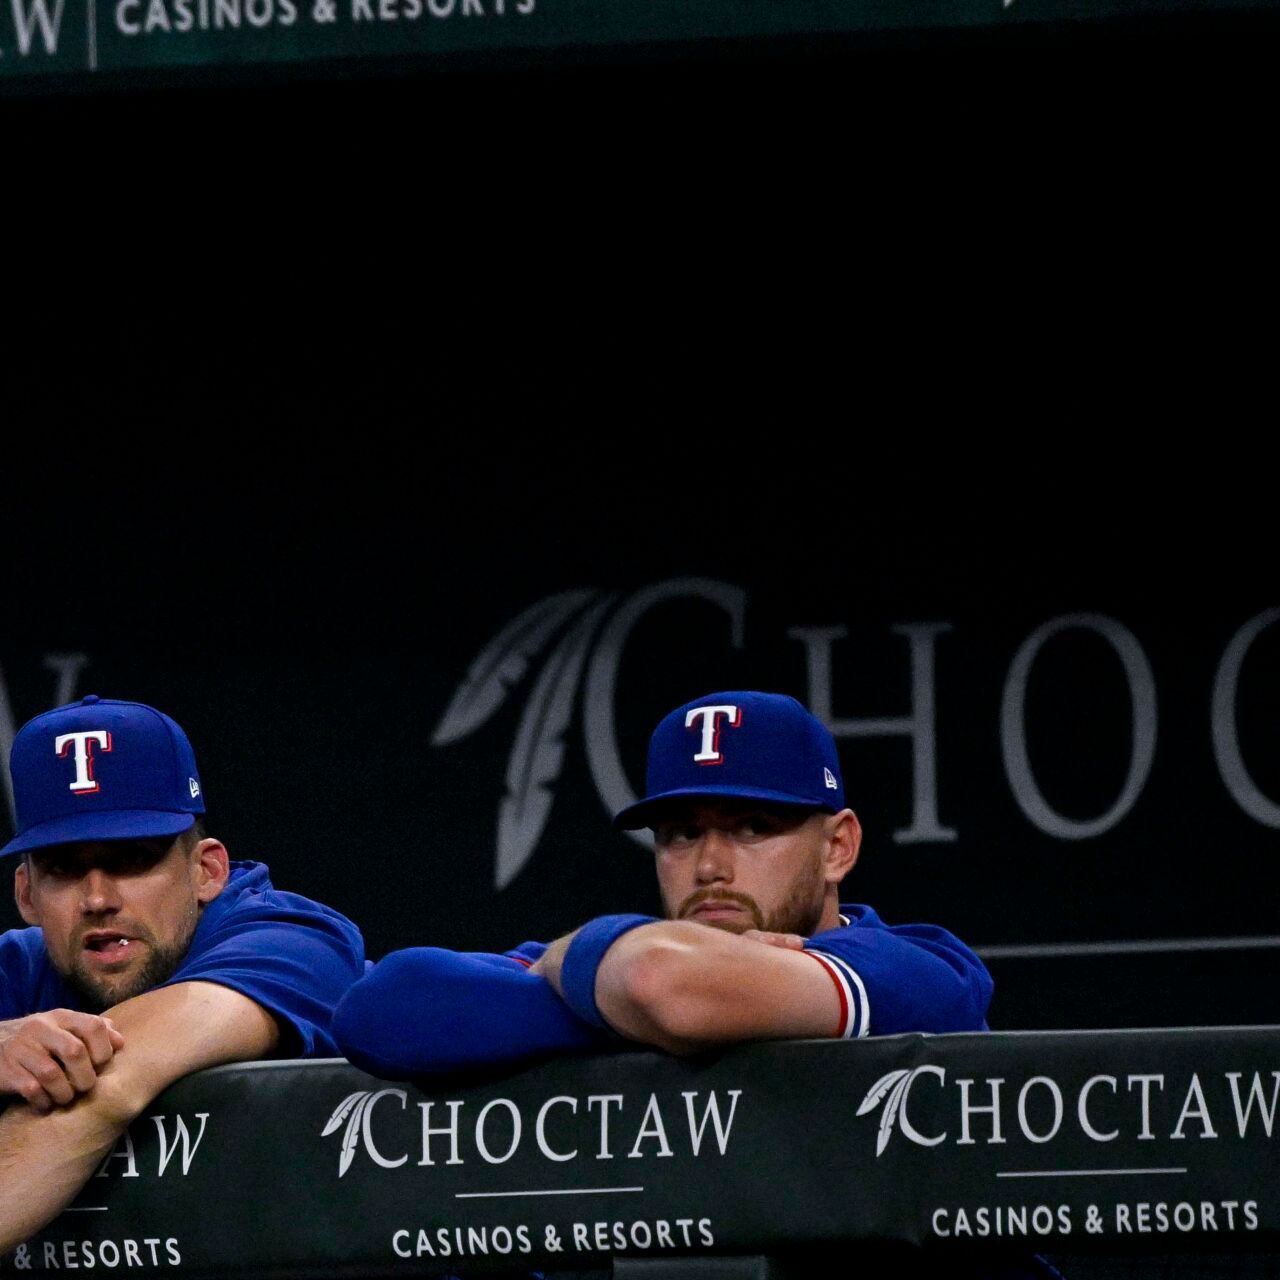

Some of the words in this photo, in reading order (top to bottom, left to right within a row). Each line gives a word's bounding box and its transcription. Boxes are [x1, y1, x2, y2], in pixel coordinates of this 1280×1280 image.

[54, 730, 113, 794] T
[684, 705, 743, 766] T
[362, 1088, 743, 1169] CHOCTAW
[898, 1064, 1280, 1147] CHOCTAW
[391, 1224, 532, 1259] CASINOS
[544, 1224, 564, 1253] &
[572, 1217, 715, 1251] RESORTS
[932, 1204, 1073, 1237] CASINOS
[1085, 1204, 1104, 1234] &
[1115, 1200, 1260, 1233] RESORTS
[43, 1237, 183, 1270] RESORTS
